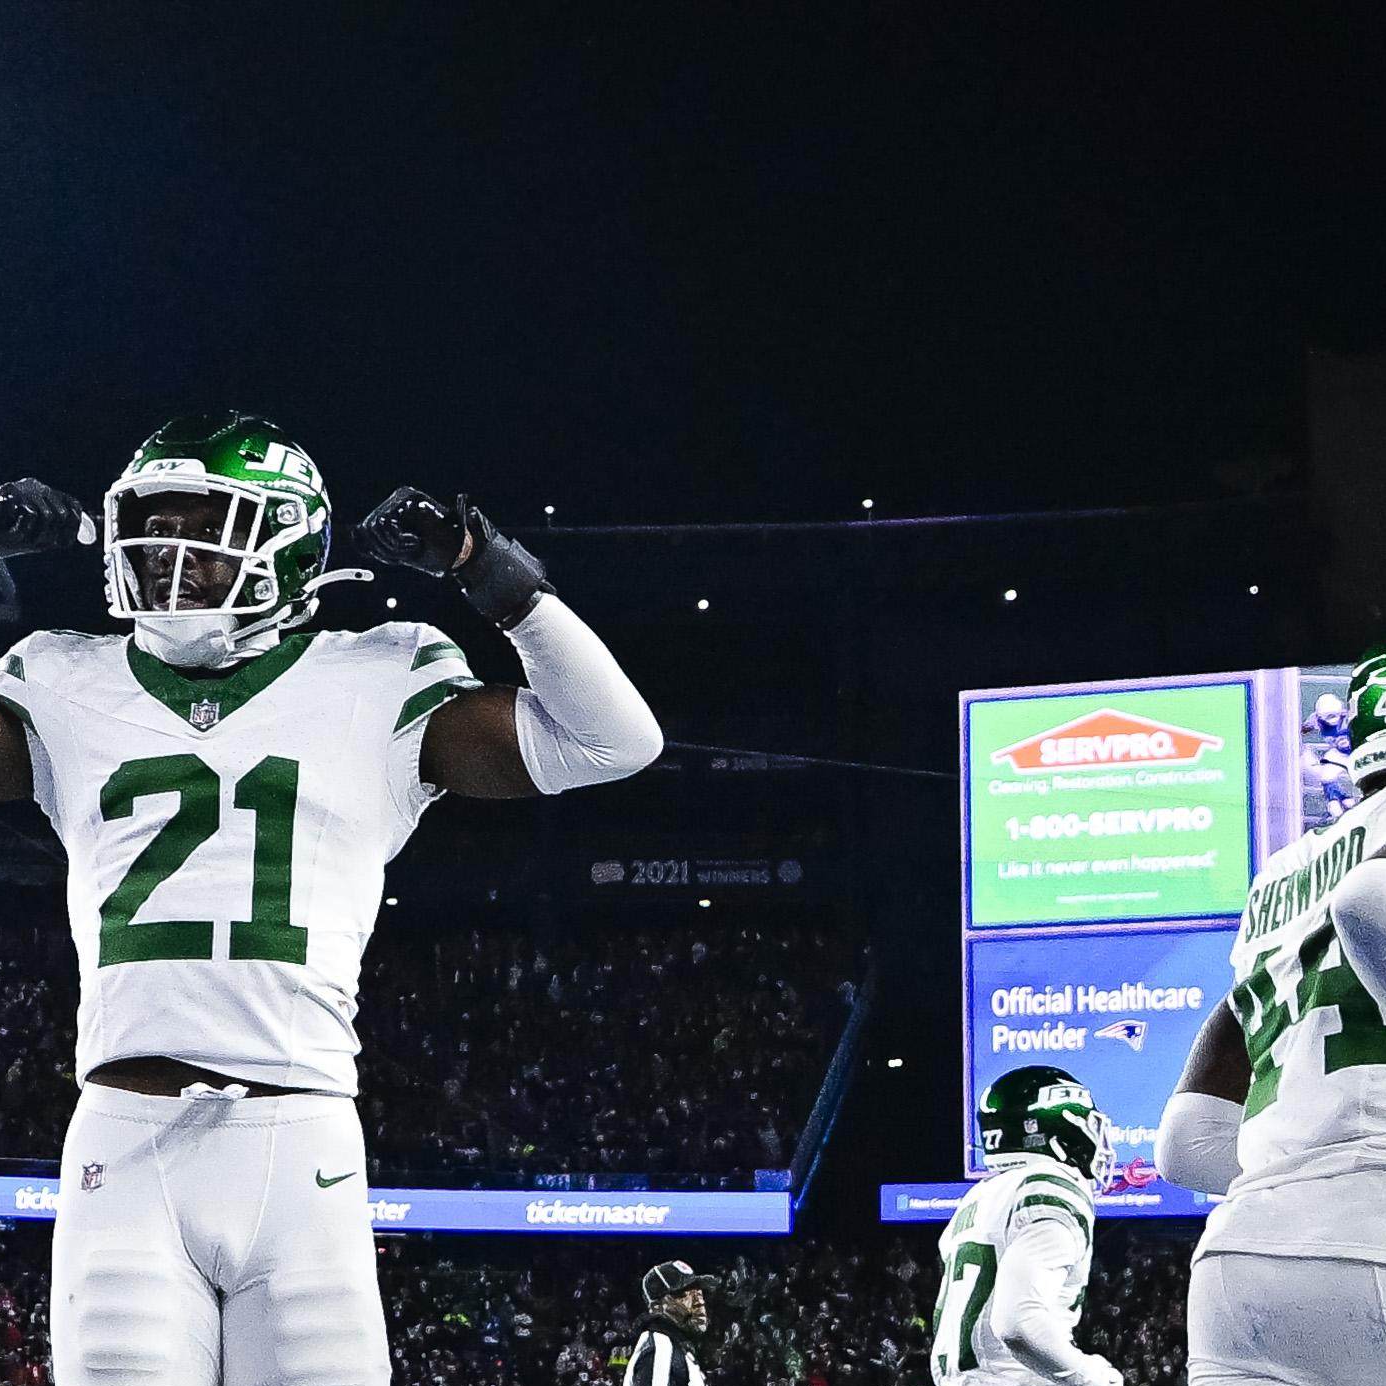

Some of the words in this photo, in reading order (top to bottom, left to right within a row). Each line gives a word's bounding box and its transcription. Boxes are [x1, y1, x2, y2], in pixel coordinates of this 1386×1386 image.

[1040, 731, 1176, 765] SERVPRO
[1005, 806, 1214, 841] 1-800-SERVPRO
[98, 753, 308, 968] 21
[631, 859, 691, 884] 2021
[997, 861, 1030, 880] Like
[1031, 860, 1045, 876] it
[1045, 859, 1089, 875] never
[1091, 857, 1130, 873] even
[990, 984, 1075, 1018] Official
[1076, 980, 1204, 1014] Healthcare
[991, 1018, 1088, 1053] Provider
[1111, 1126, 1159, 1147] Brigha
[525, 1200, 671, 1227] ticketmaster
